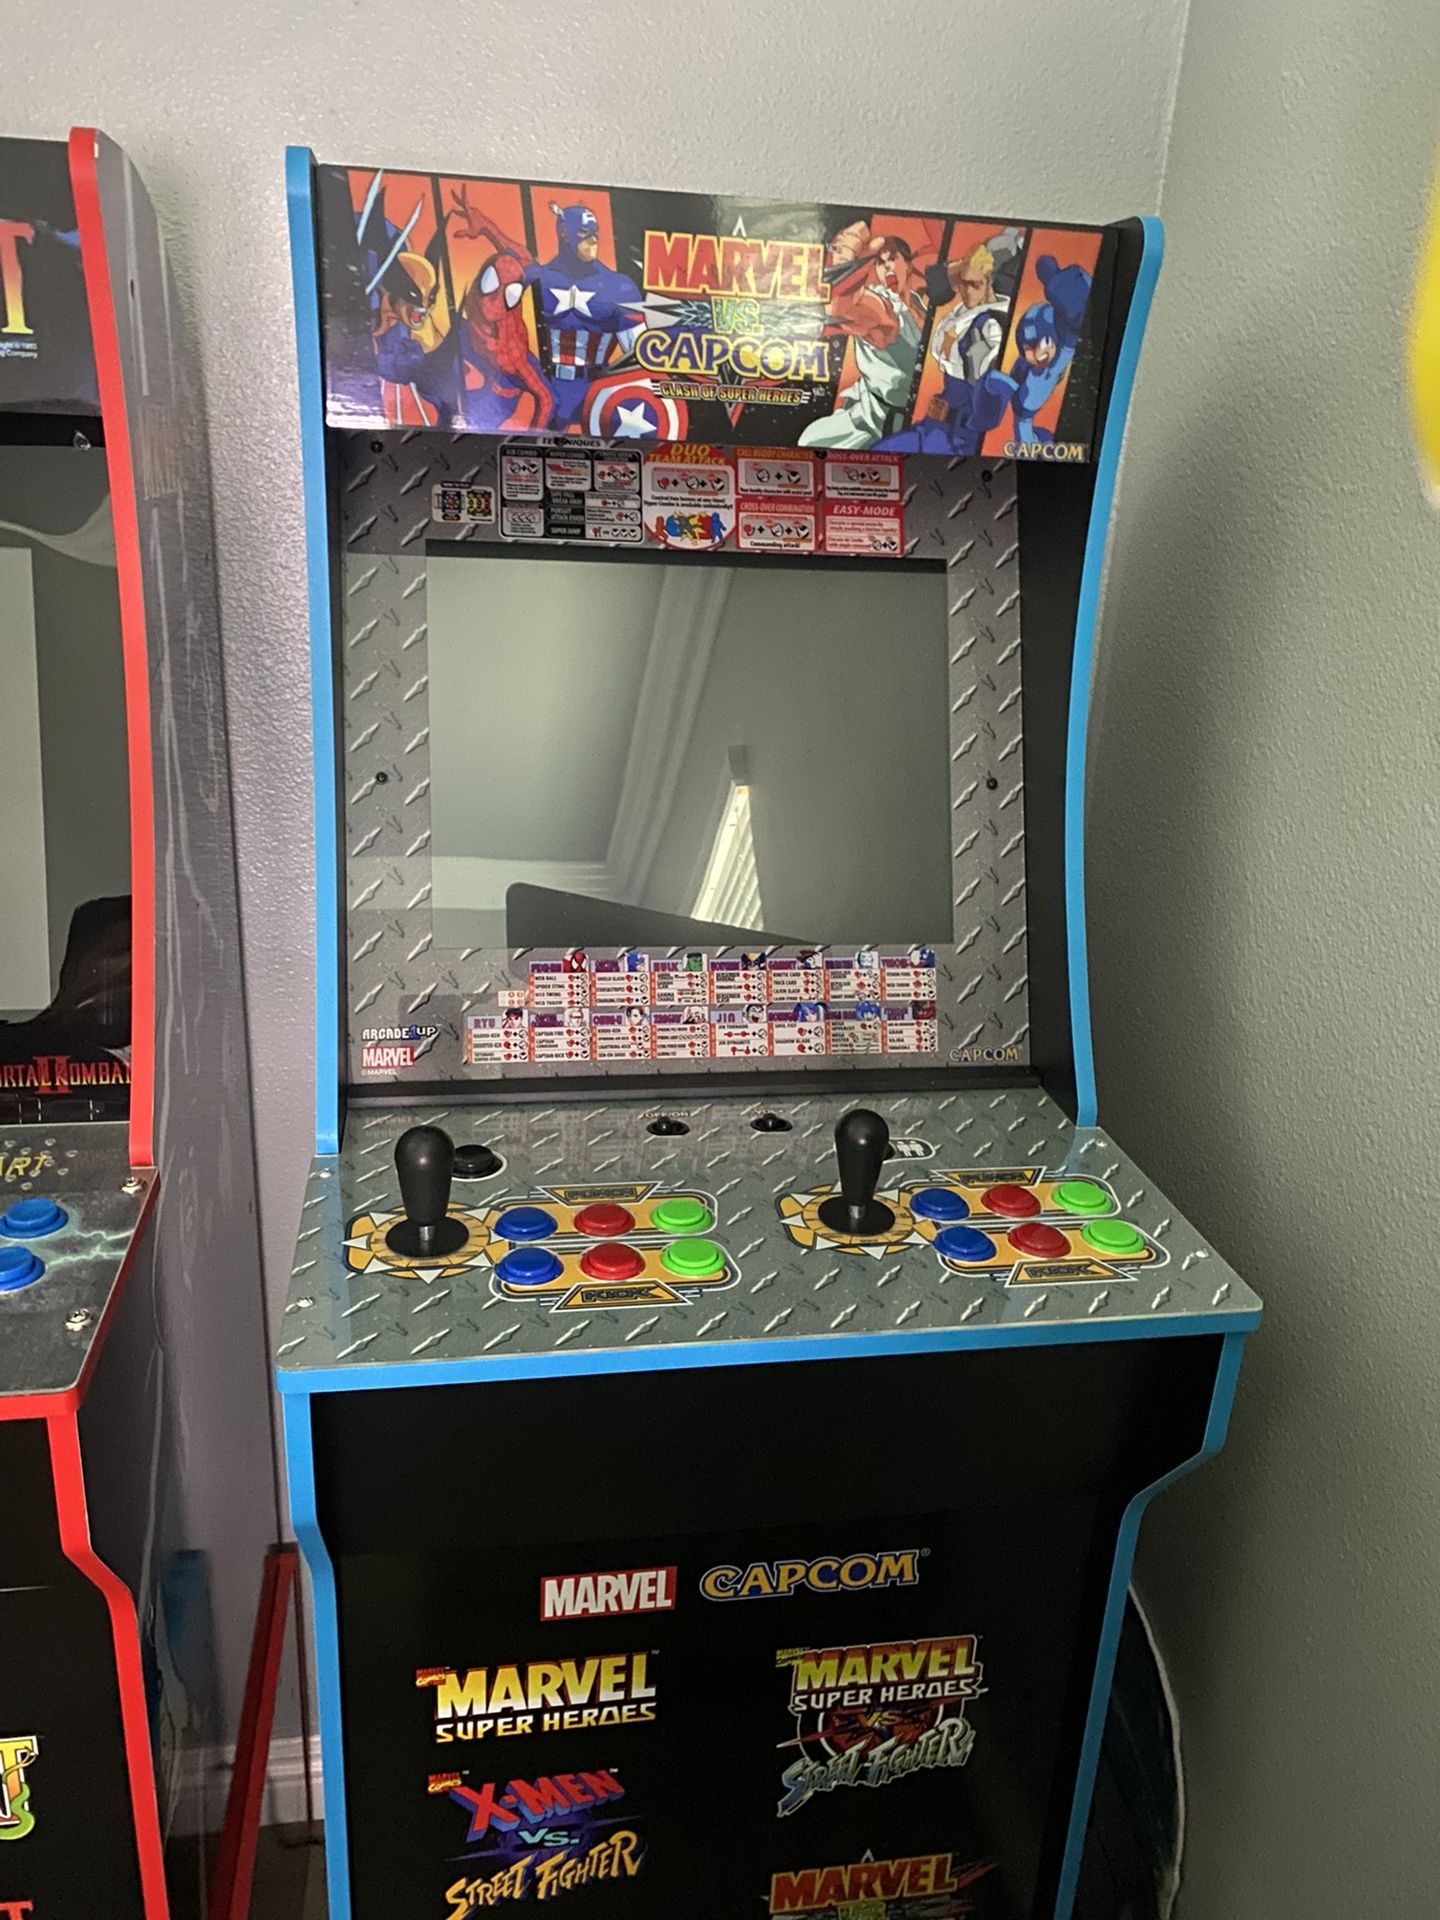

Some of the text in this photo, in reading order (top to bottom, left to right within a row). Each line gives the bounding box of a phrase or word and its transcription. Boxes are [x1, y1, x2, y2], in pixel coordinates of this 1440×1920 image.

[643, 230, 831, 304] MARVEL
[711, 296, 764, 336] VS.
[635, 331, 830, 383] CAPCOM
[659, 382, 801, 404] CLASH OF SUPER HEROES
[542, 437, 600, 447] TENIQUES
[670, 443, 710, 457] DUO
[1003, 441, 1084, 461] CAPCOM
[649, 453, 726, 466] TEAM ATTACK
[827, 451, 870, 461] ROSS-OVER
[833, 504, 896, 516] EASY-MODE
[474, 1018, 496, 1029] RYU
[716, 1013, 736, 1023] JIN
[362, 1024, 438, 1041] ARCADE1UP
[362, 1046, 414, 1069] MARVEL
[948, 1047, 1019, 1062] CAPCOM
[0, 1063, 52, 1088] RTAL
[699, 1549, 920, 1601] CAPCOM
[542, 1568, 674, 1620] MARVEL
[795, 1638, 977, 1690] MARVEL
[435, 1652, 657, 1719] MARVEL
[794, 1679, 974, 1711] SUPER HEROES
[435, 1702, 657, 1744] SUPER HEROES
[776, 1717, 977, 1818] STREET FIGHTER
[449, 1769, 625, 1843] X-MEN
[518, 1827, 580, 1847] VS.
[445, 1830, 643, 1920] STREET FIGHTER
[769, 1852, 960, 1915] MARVEL
